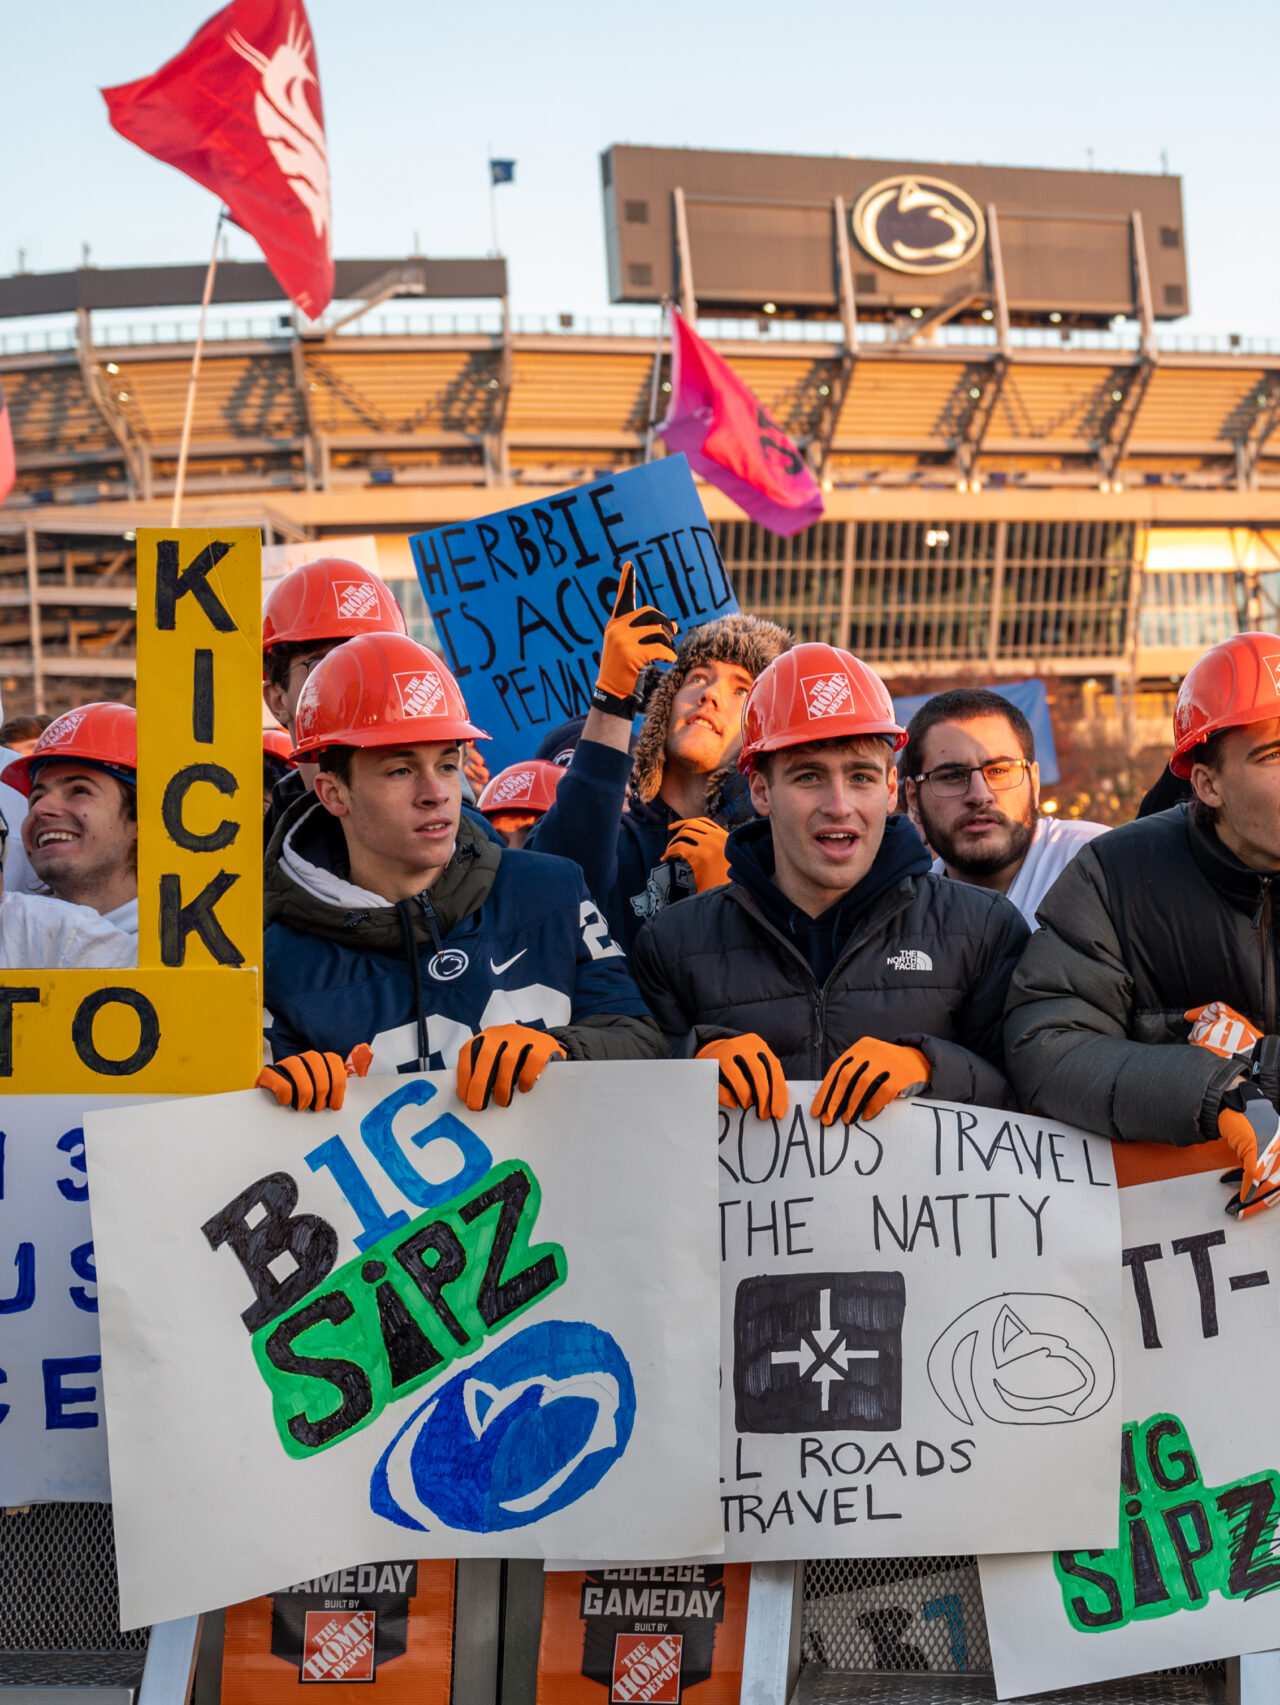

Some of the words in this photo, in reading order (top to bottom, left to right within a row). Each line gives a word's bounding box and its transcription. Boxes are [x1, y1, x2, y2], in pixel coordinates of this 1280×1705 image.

[417, 484, 639, 596] HERBBIE
[339, 582, 376, 617] HOME
[341, 585, 357, 598] THE
[356, 596, 379, 617] DEPOT
[433, 601, 497, 678] IS
[516, 595, 575, 661] A
[403, 671, 442, 717] HOME
[404, 676, 422, 694] THE
[422, 687, 444, 716] DEPOT
[809, 679, 827, 697] THE
[809, 673, 849, 718] HOME
[827, 686, 850, 715] DEPOT
[155, 540, 244, 968] KICK
[494, 771, 534, 803] HOME
[887, 957, 917, 965] NORTH
[911, 1102, 1111, 1187] TRAVEL
[719, 1197, 814, 1262] THE
[873, 1193, 1051, 1259] NATTY
[800, 1437, 976, 1478] ROADS
[720, 1484, 902, 1535] TRAVEL
[324, 1599, 347, 1609] BUILT
[348, 1599, 360, 1609] BY
[584, 1588, 722, 1618] GAMEDAY
[312, 1618, 342, 1646] THE
[634, 1622, 656, 1632] BUILT
[657, 1623, 668, 1632] BY
[303, 1611, 375, 1680] HOME
[330, 1637, 374, 1680] DEPOT
[621, 1642, 651, 1669] THE
[613, 1635, 682, 1702] HOME
[638, 1660, 679, 1702] DEPOT
